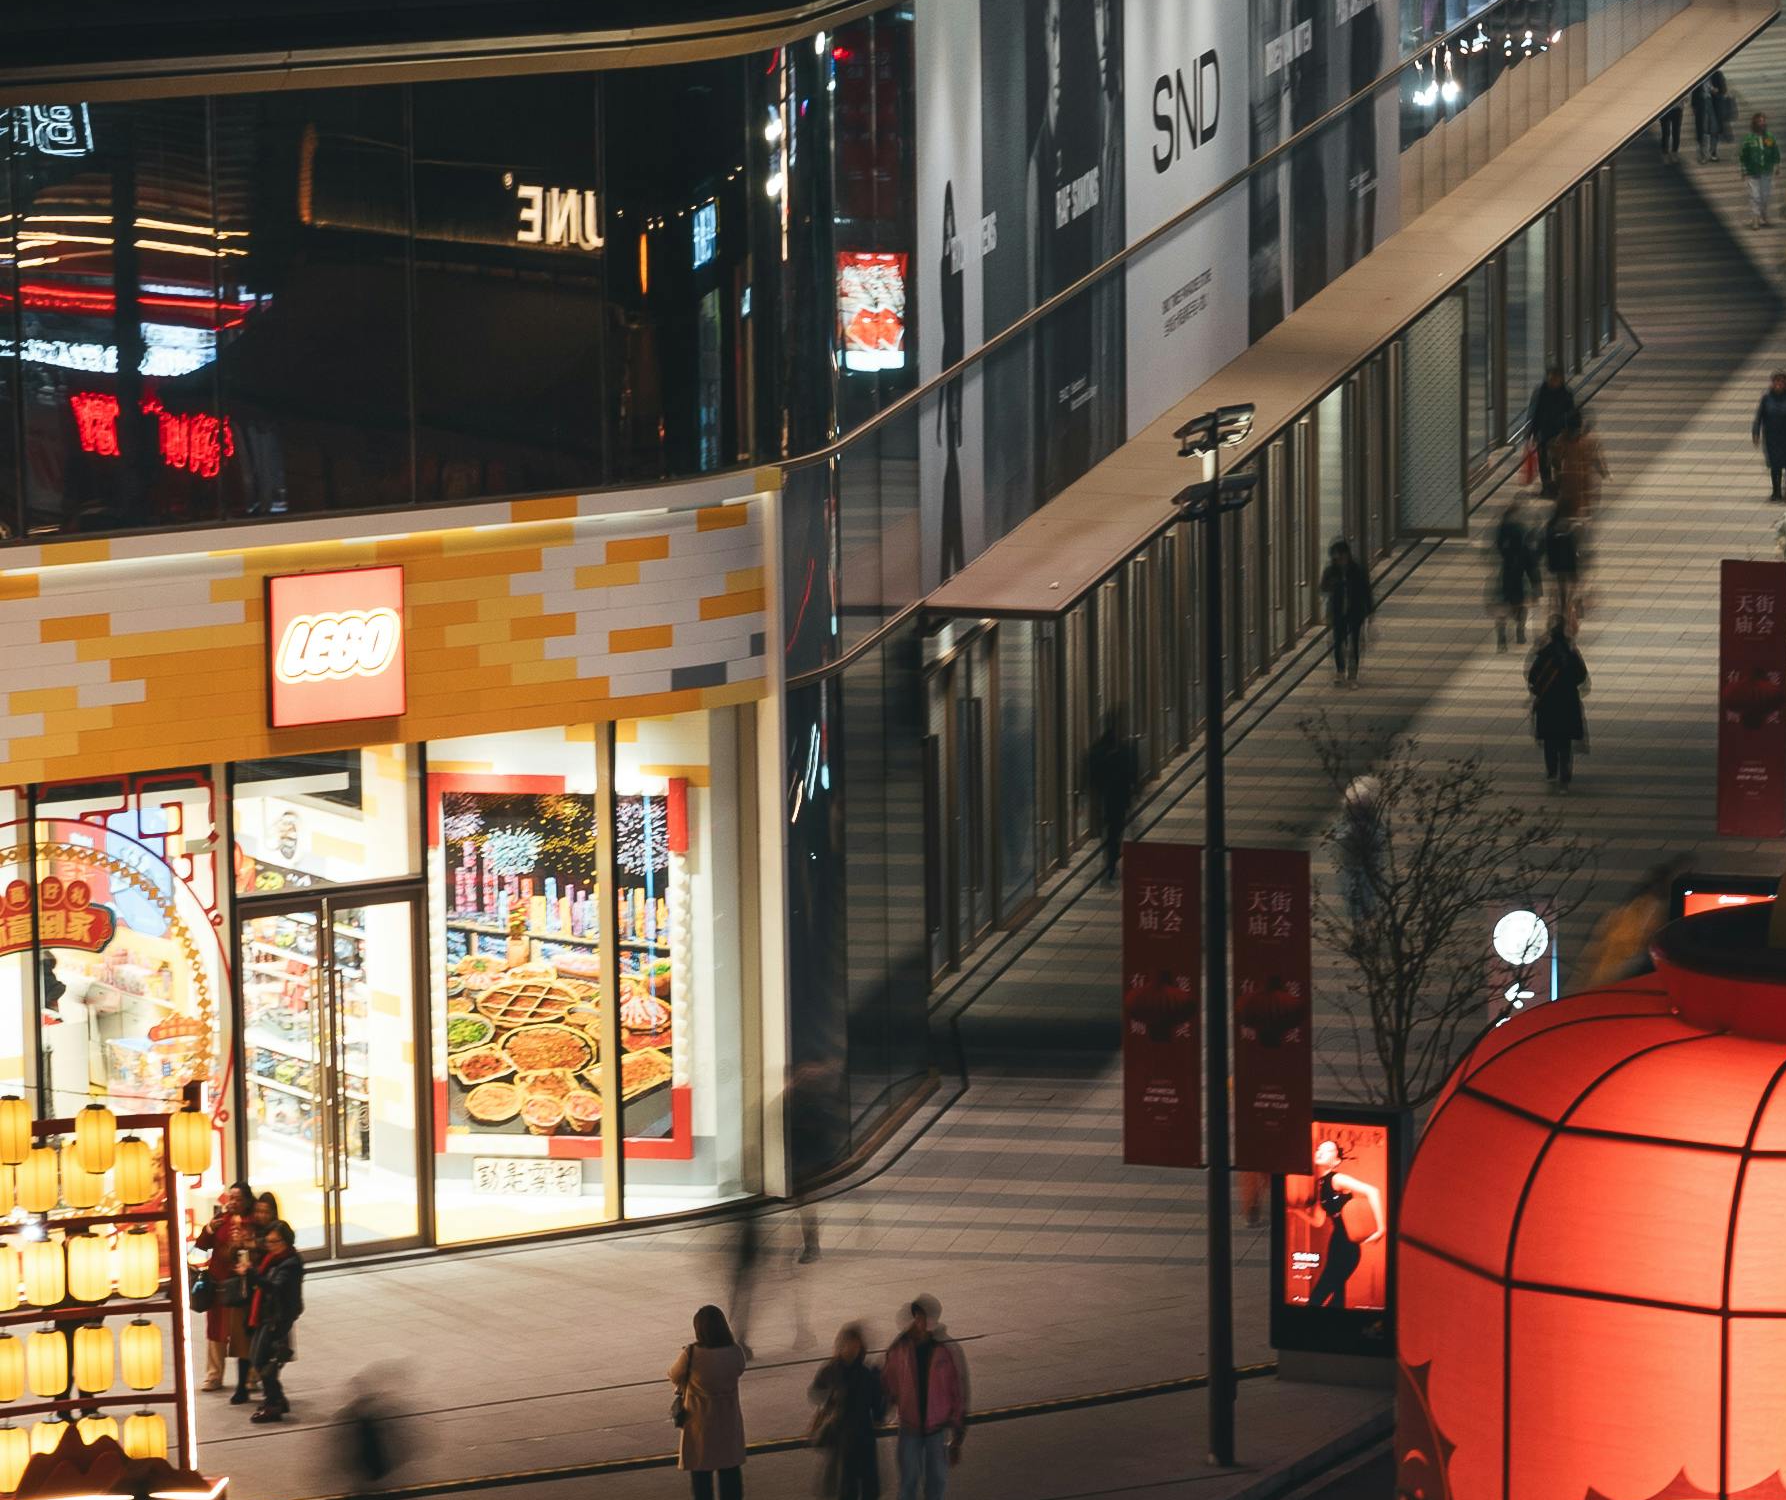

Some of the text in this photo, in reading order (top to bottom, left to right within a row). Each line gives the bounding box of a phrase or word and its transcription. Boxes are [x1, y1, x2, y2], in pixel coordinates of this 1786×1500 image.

[1151, 49, 1221, 176] SND
[1735, 594, 1776, 614] 天街
[281, 610, 397, 680] LEGO
[1138, 885, 1184, 909] 天街
[1247, 890, 1293, 913] 天街
[1137, 910, 1184, 933] 庙会
[1247, 915, 1293, 938] 庙会
